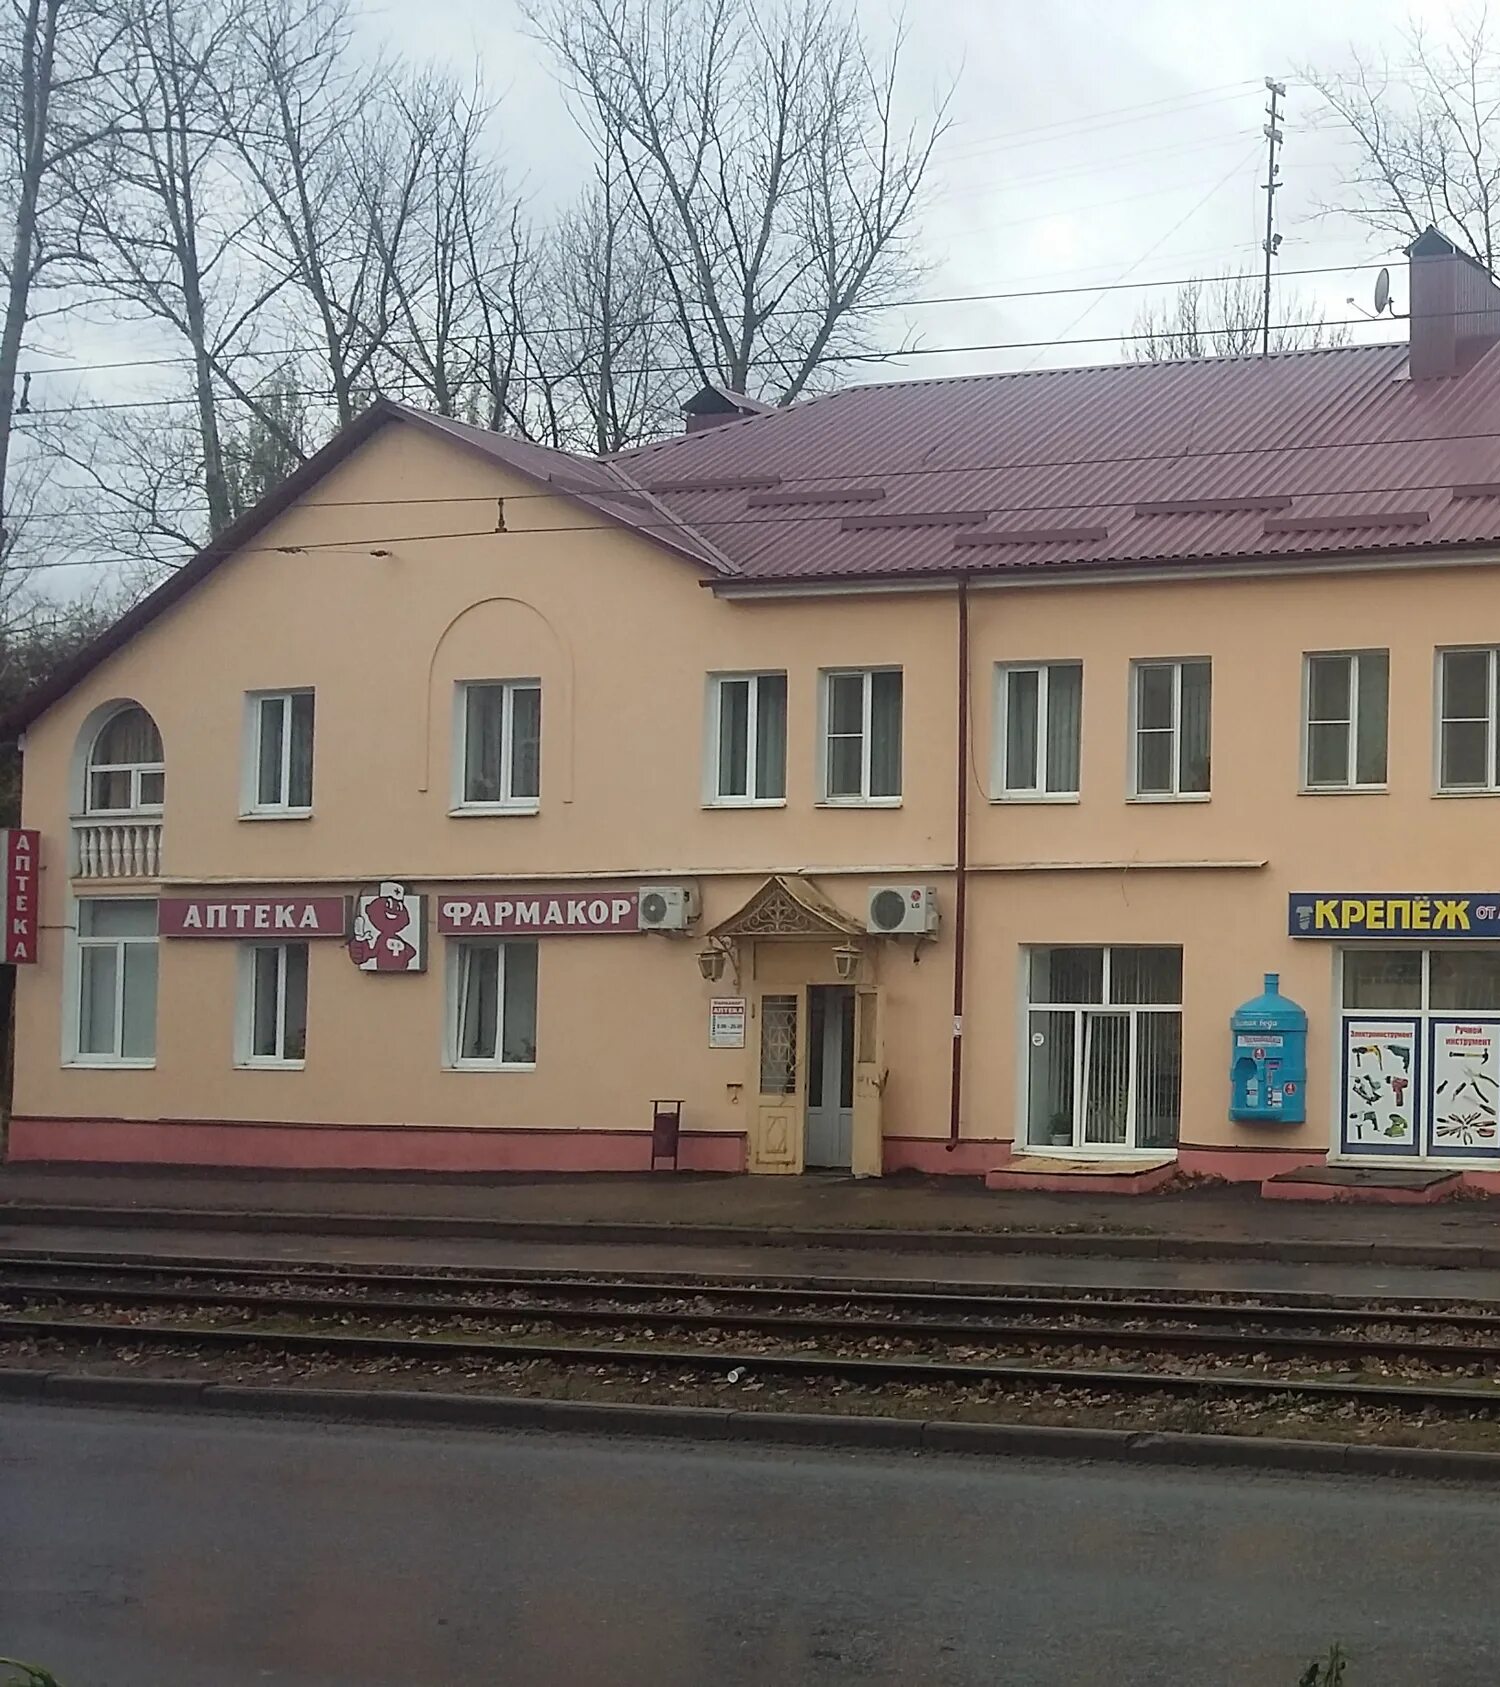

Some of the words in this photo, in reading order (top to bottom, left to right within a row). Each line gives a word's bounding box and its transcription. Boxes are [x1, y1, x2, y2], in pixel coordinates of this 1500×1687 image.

[13, 834, 30, 958] АПТЕКА
[182, 904, 319, 929] АПТЕКА
[442, 899, 632, 927] ФАРМАКОР
[1314, 896, 1471, 930] КРЕПЁЖ
[1476, 906, 1496, 919] от
[1445, 1038, 1491, 1046] инструмент
